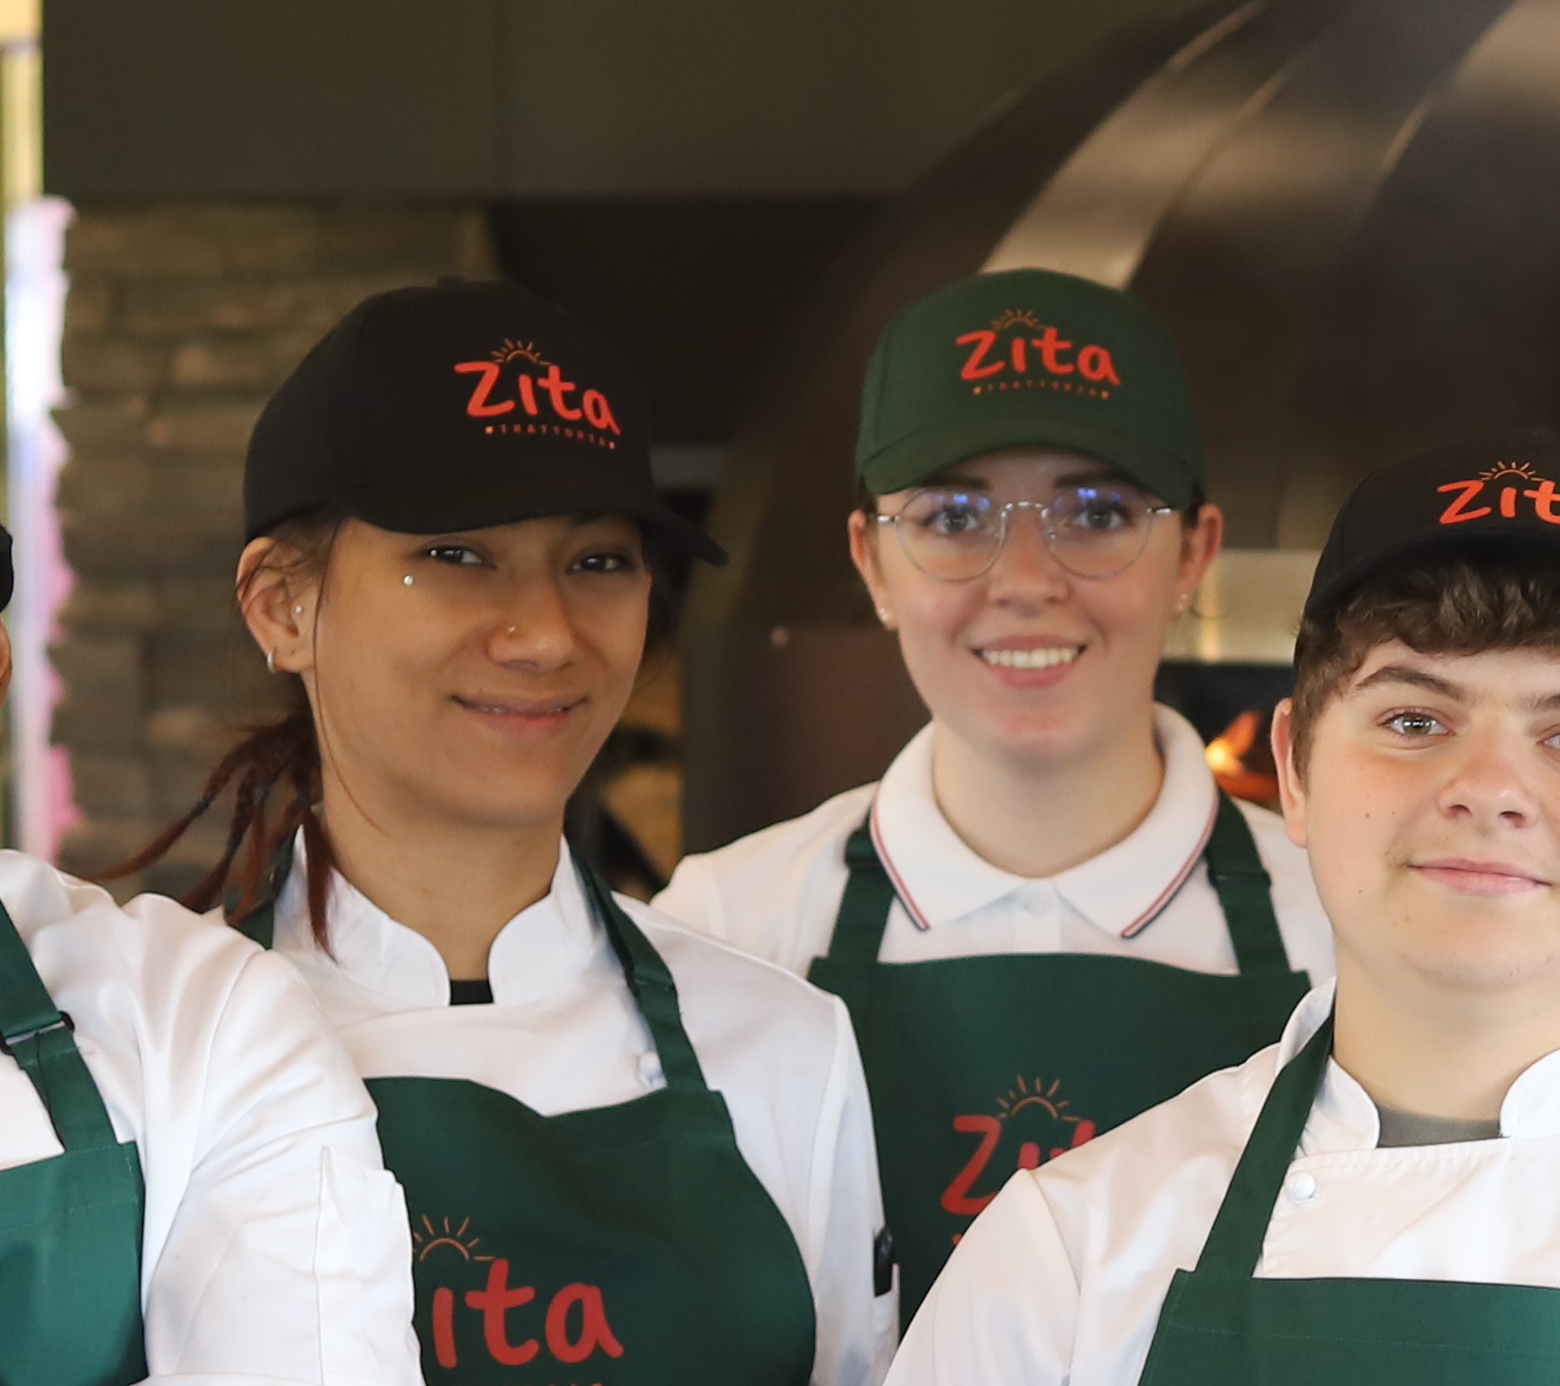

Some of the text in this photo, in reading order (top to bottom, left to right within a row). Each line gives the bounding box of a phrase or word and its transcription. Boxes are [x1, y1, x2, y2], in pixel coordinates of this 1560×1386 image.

[954, 326, 1121, 381] Zita
[453, 360, 622, 436] Zita
[431, 1257, 625, 1370] ita
